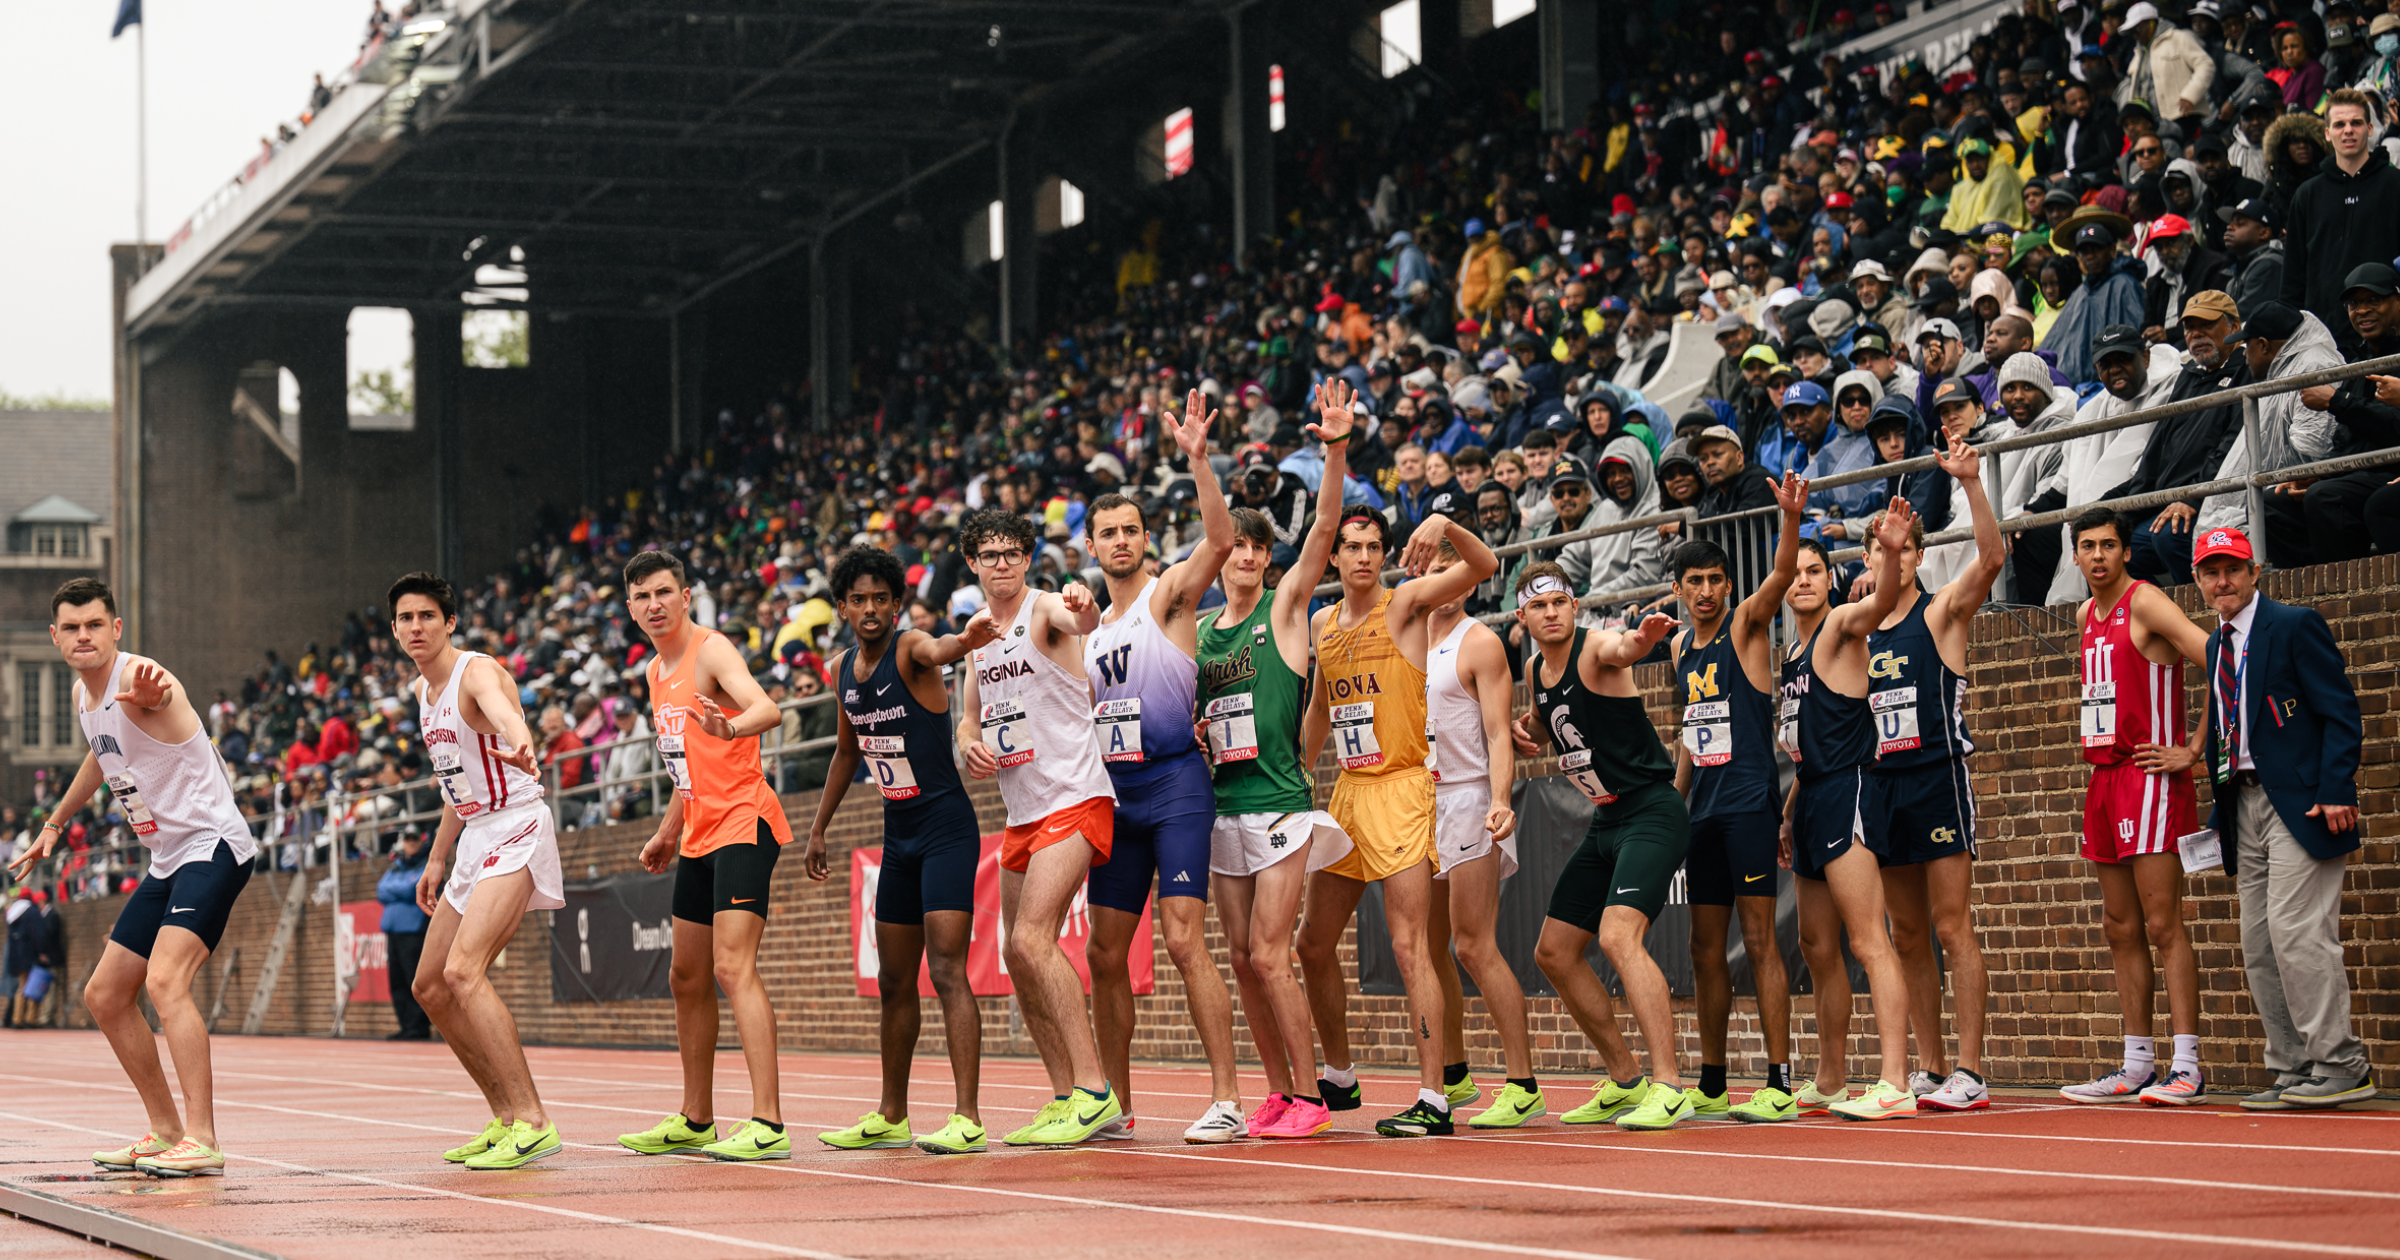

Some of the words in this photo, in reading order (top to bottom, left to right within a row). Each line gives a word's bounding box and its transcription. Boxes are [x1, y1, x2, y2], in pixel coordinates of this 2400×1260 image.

[977, 659, 1035, 686] IRGINIA
[1096, 643, 1132, 688] W
[1202, 644, 1257, 694] Irish
[1867, 650, 1908, 680] GT
[1687, 662, 1720, 704] M
[1779, 673, 1810, 702] CONN
[1222, 696, 1240, 705] PENN
[1884, 695, 1909, 704] RELAYS
[1885, 690, 1903, 700] PENN
[995, 700, 1010, 710] PENN
[995, 705, 1017, 716] RELAYS
[1110, 706, 1133, 714] RELAYS
[1222, 701, 1245, 711] RELAYS
[1697, 709, 1722, 717] RELAYS
[2282, 698, 2297, 718] P
[1344, 710, 1368, 718] RELAYS
[2096, 707, 2105, 733] L
[1882, 712, 1900, 740] U
[424, 728, 459, 749] ISCONSIN
[997, 725, 1015, 753] C
[1110, 724, 1126, 753] A
[1225, 721, 1232, 748] I
[1343, 728, 1363, 756] H
[1696, 727, 1713, 754] P
[2093, 735, 2112, 745] TOYOTA
[1882, 739, 1915, 751] TOYOTA
[1000, 752, 1031, 767] TOYOTA
[1110, 753, 1138, 762] TOYOTA
[1221, 748, 1252, 761] TOYOTA
[1348, 753, 1380, 767] TOYOTA
[1700, 754, 1726, 764] TOYOTA
[439, 759, 456, 769] RELAYS
[876, 760, 895, 787] D
[443, 778, 462, 804] E
[884, 787, 914, 799] TOYOTA
[1577, 774, 1597, 797] S
[455, 801, 480, 817] TOYOTA
[1930, 826, 1956, 843] GT
[483, 855, 501, 869] W
[632, 920, 660, 951] Dream
